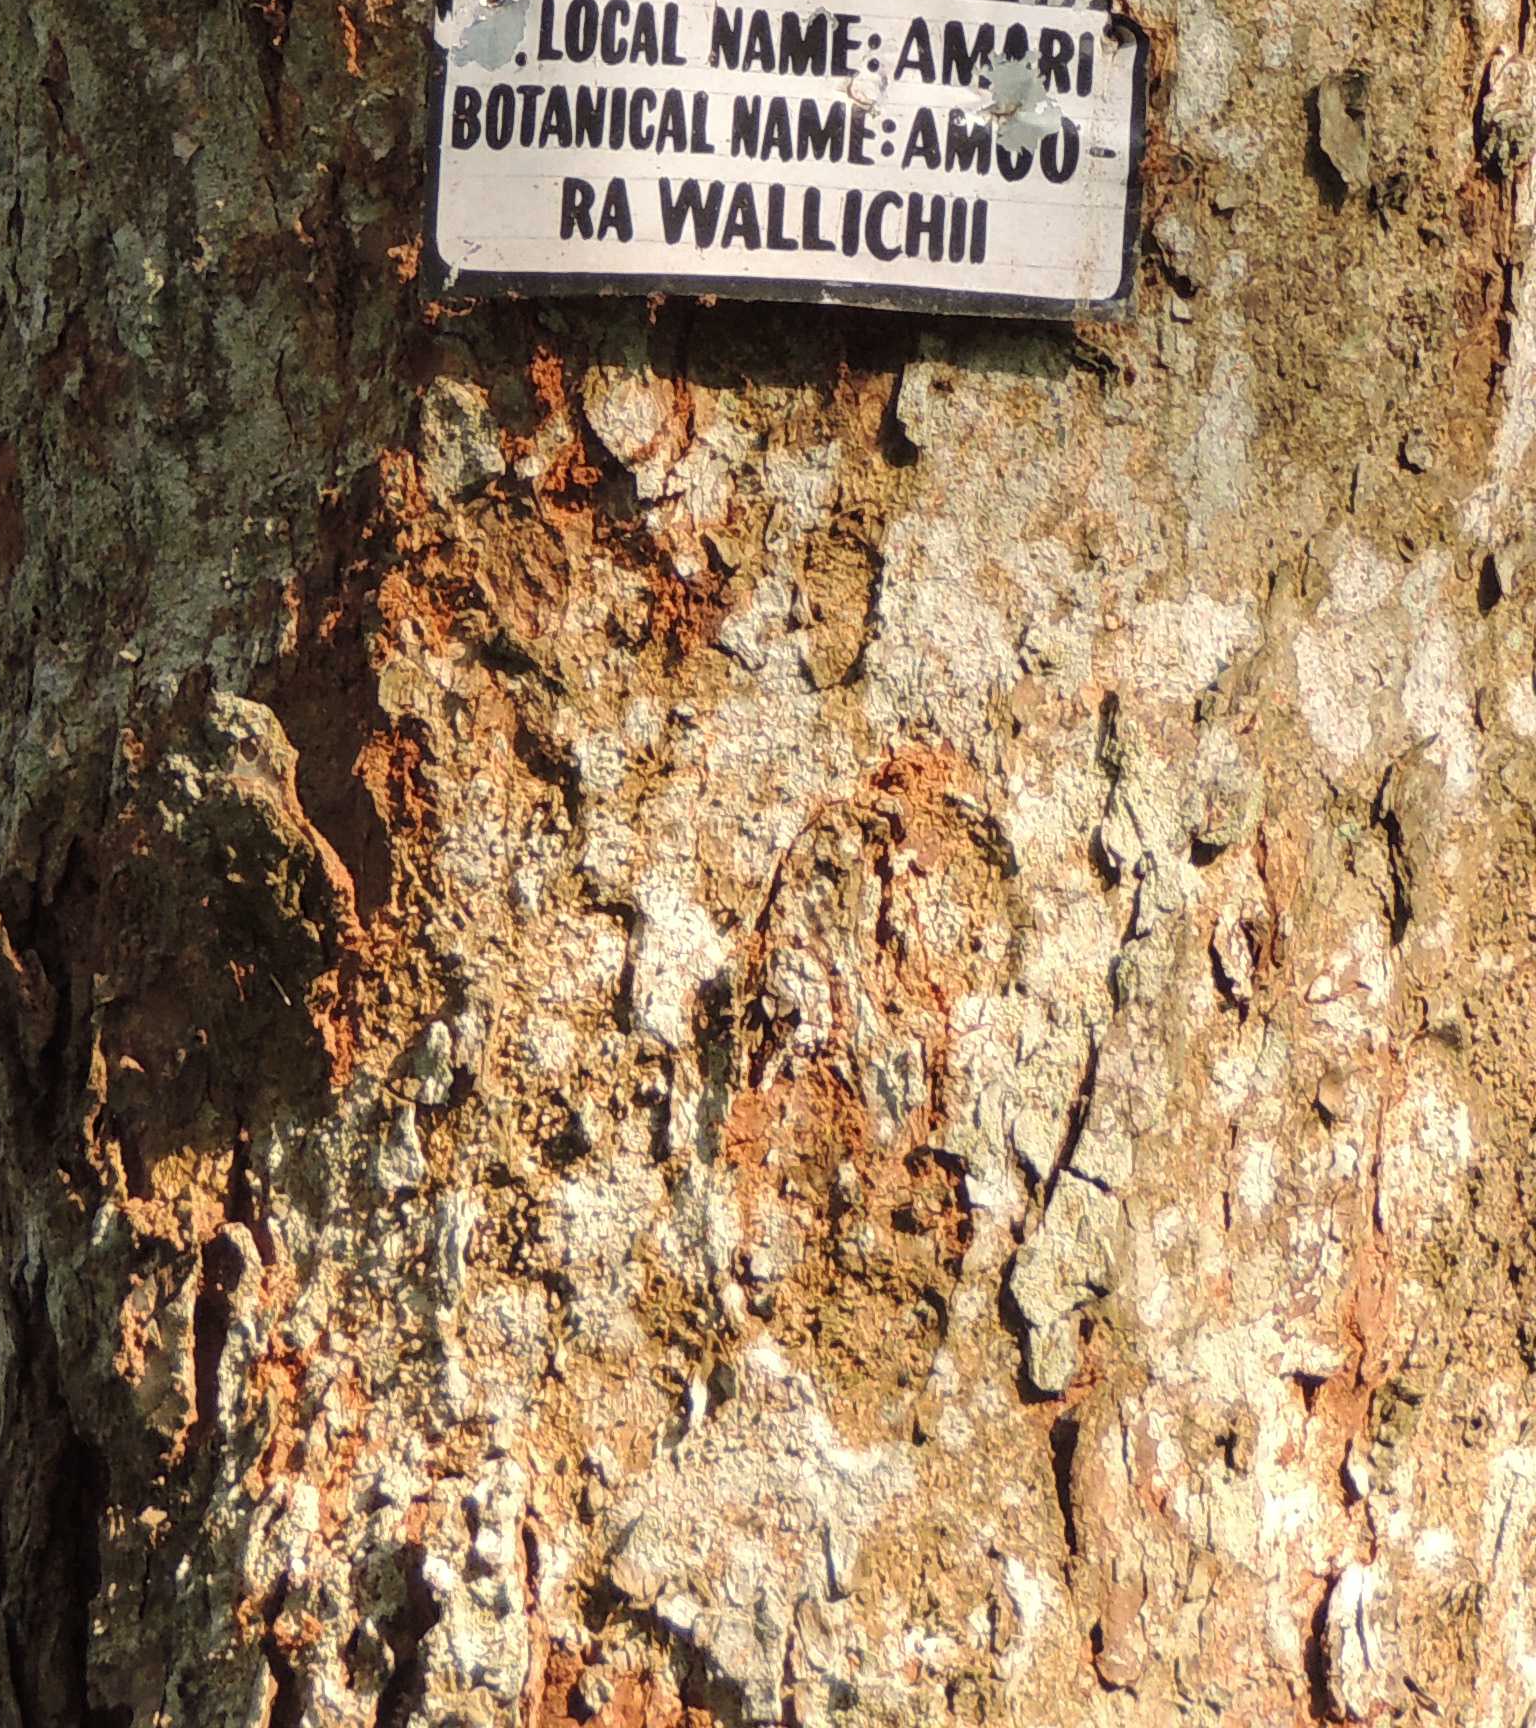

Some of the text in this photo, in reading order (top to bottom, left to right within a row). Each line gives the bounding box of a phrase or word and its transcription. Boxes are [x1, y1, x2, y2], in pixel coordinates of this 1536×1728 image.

[451, 83, 715, 155] BOTANICAL
[559, 176, 988, 264] RA WALLICHII
